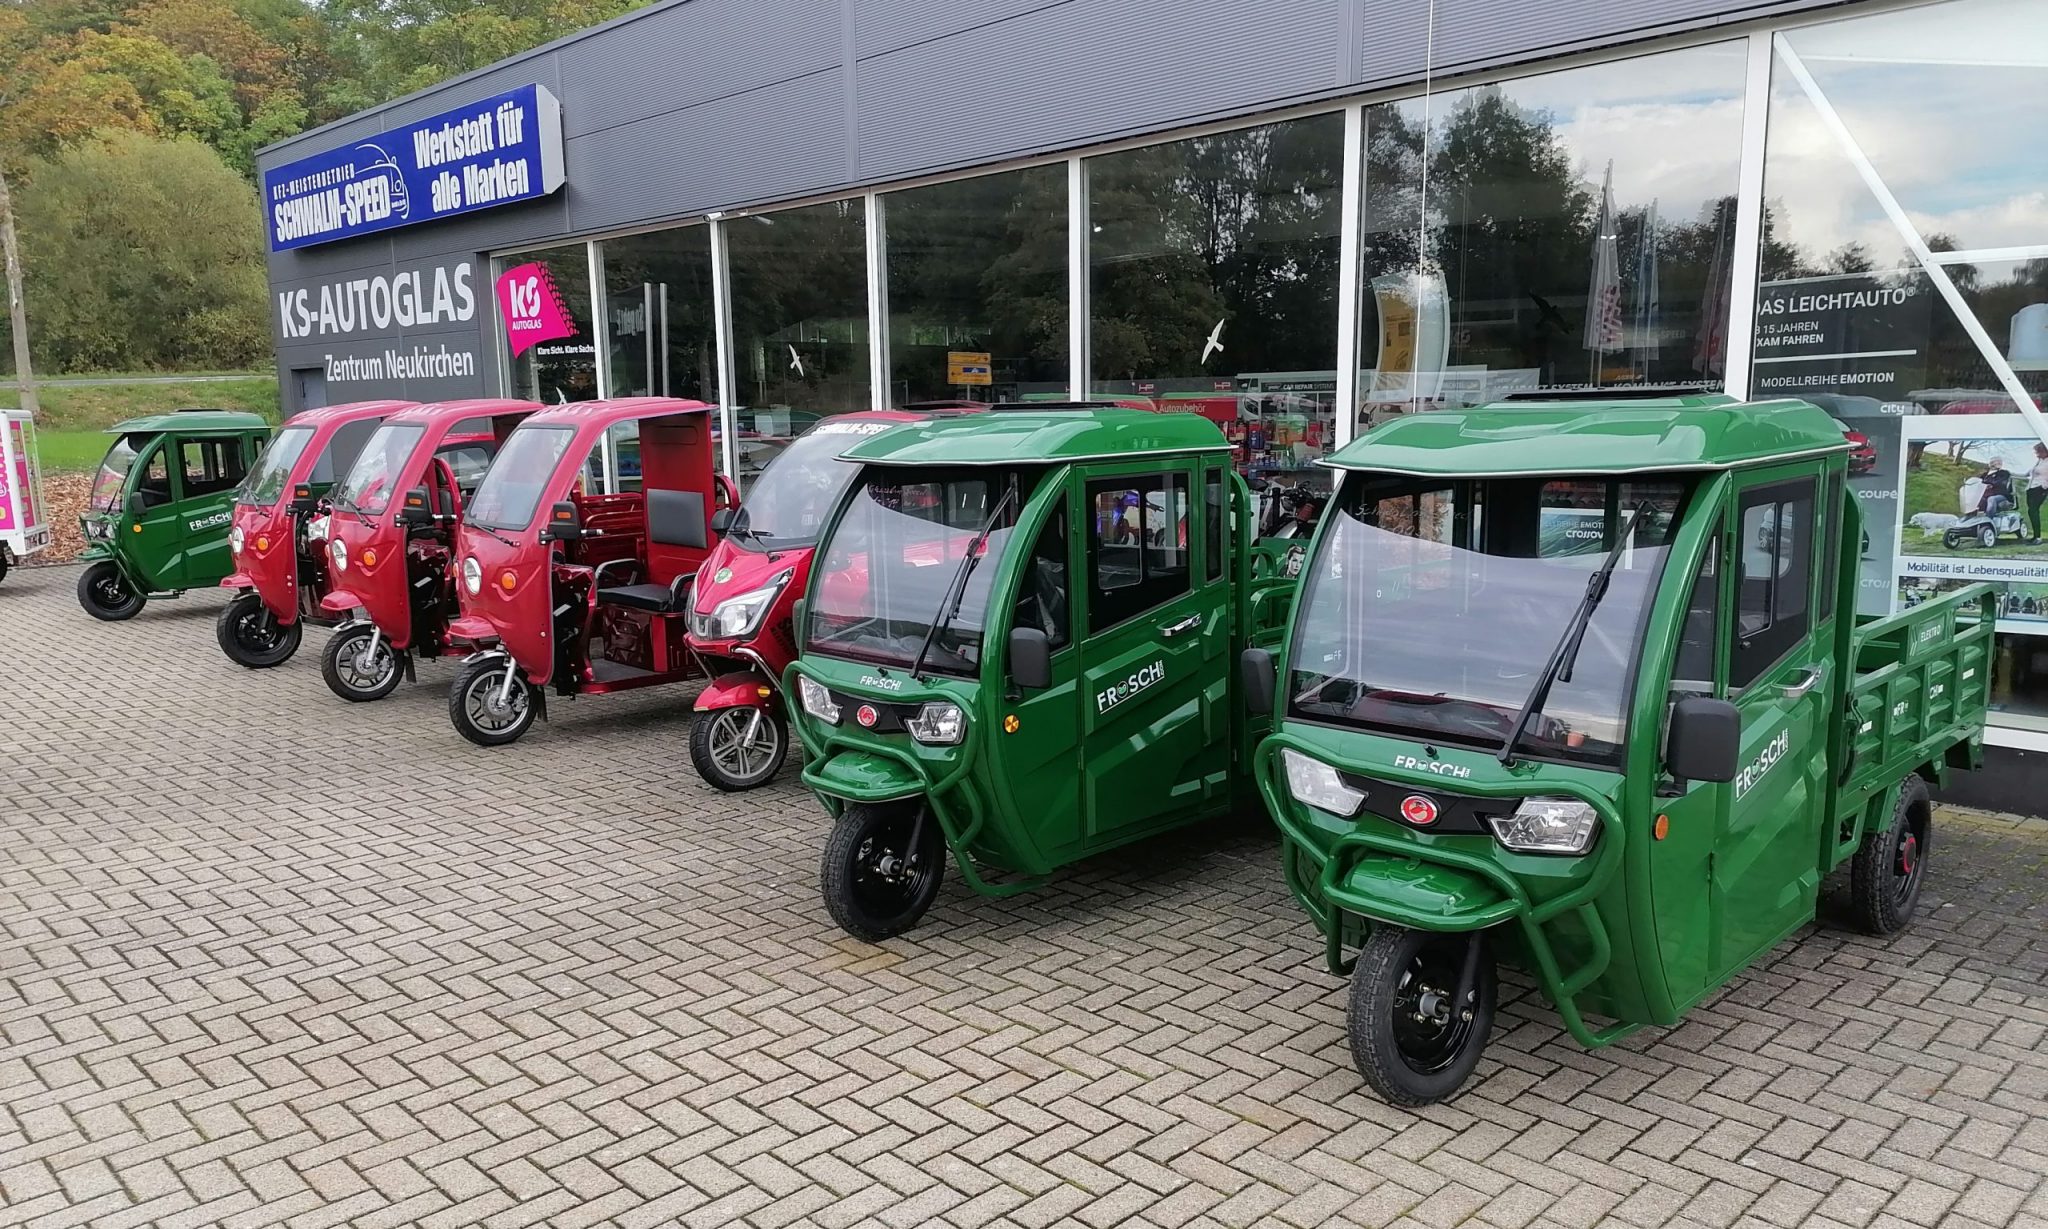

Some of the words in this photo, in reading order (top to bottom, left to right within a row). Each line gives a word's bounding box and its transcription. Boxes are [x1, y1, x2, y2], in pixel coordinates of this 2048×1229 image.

[413, 112, 494, 169] Werkstatt
[497, 101, 524, 148] für
[273, 163, 355, 200] KFZ-MEISTERBETRIEB
[431, 171, 461, 213] alle
[463, 158, 530, 206] Marken
[275, 174, 391, 243] SCHWALM-SPEED
[279, 262, 475, 338] KS-AUTOGLAS
[509, 276, 541, 318] KS
[512, 319, 542, 331] AUTOGLAS
[1763, 324, 1775, 334] 15
[1776, 321, 1819, 333] JAHREN
[1782, 334, 1824, 345] FAHREN
[325, 354, 383, 382] Zentrum
[385, 344, 474, 379] Neukirchen
[1761, 375, 1838, 388] MODELLREIHE
[1839, 372, 1895, 384] EMOTION
[1159, 403, 1207, 414] Autozubehör
[1880, 403, 1905, 415] city
[1907, 561, 1949, 574] Mobilität
[1952, 563, 1965, 574] ist
